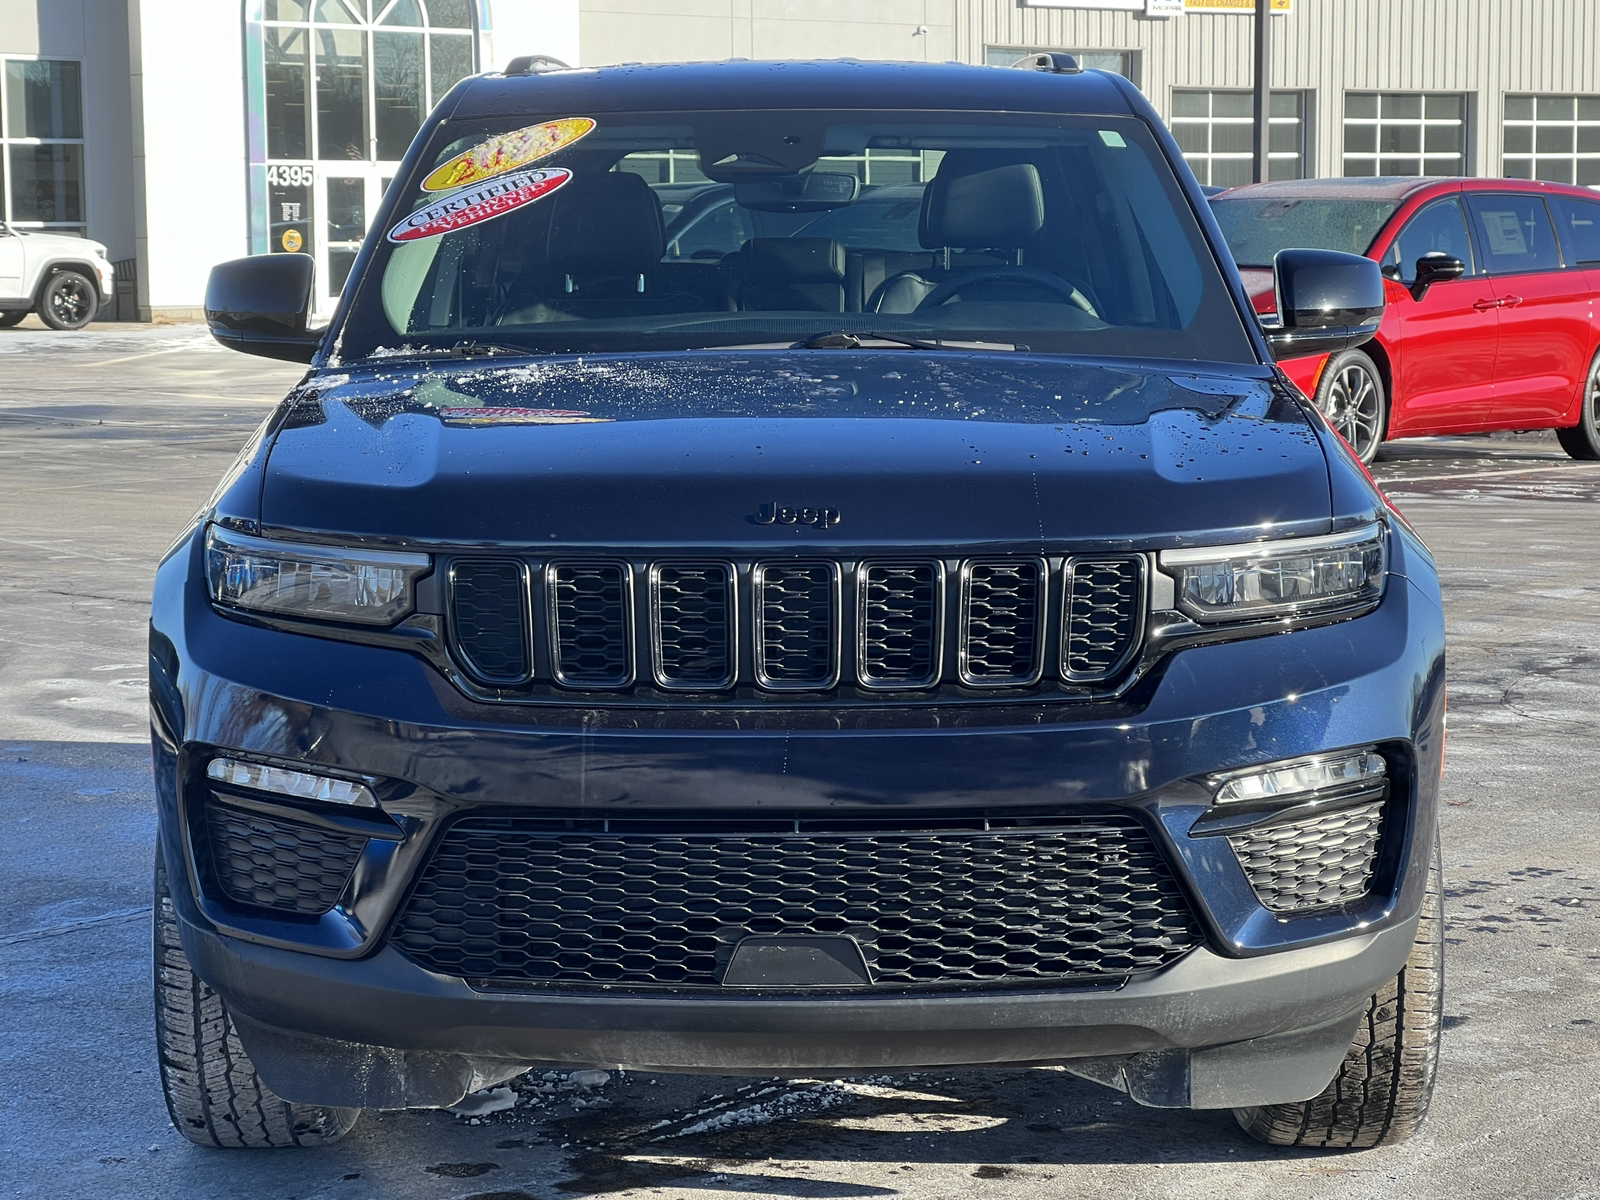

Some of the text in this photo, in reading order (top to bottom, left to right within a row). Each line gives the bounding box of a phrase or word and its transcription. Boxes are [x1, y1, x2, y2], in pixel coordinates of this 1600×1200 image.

[267, 165, 313, 187] 4395
[407, 170, 548, 228] CERTIFIED
[418, 182, 547, 233] PRE-OWNED
[441, 191, 532, 230] VEHICLE
[752, 501, 842, 530] Jeep
